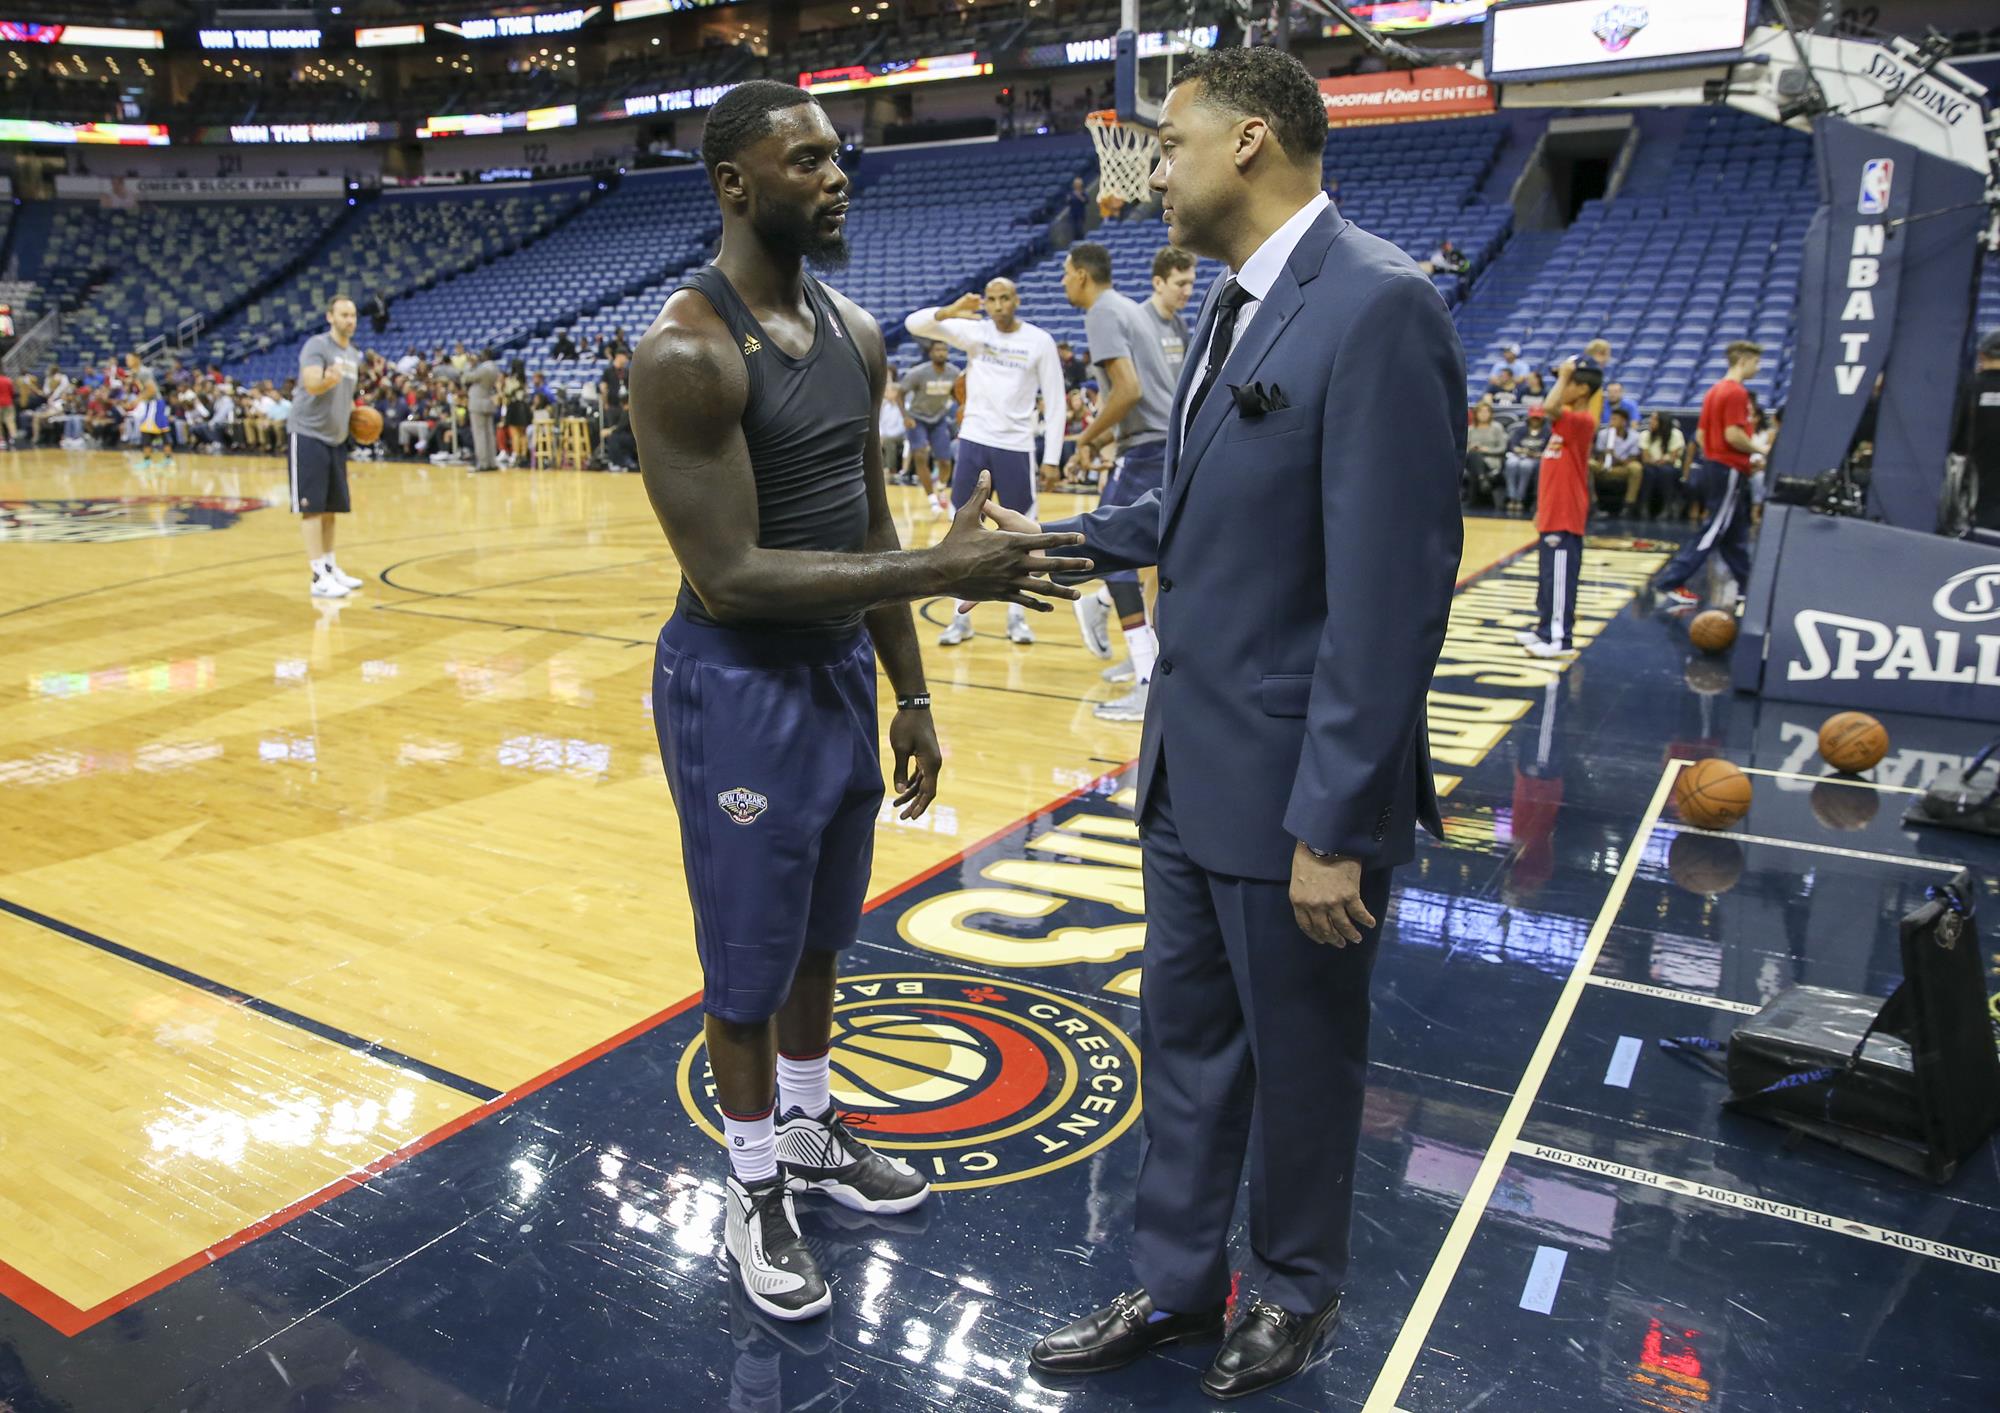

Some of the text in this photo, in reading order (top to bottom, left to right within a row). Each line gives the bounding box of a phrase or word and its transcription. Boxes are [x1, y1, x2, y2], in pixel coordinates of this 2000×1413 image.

[1066, 38, 1111, 63] WIN
[658, 89, 692, 111] THE
[1421, 84, 1489, 102] CENTER
[1863, 53, 1970, 127] SPADING
[253, 180, 301, 191] PARTY
[1834, 224, 1886, 395] NBA TV
[1028, 1003, 1124, 1155] CRESCENT
[1534, 1146, 2000, 1271] ICANS.COM PELICANS.COM PELICANS.COM
